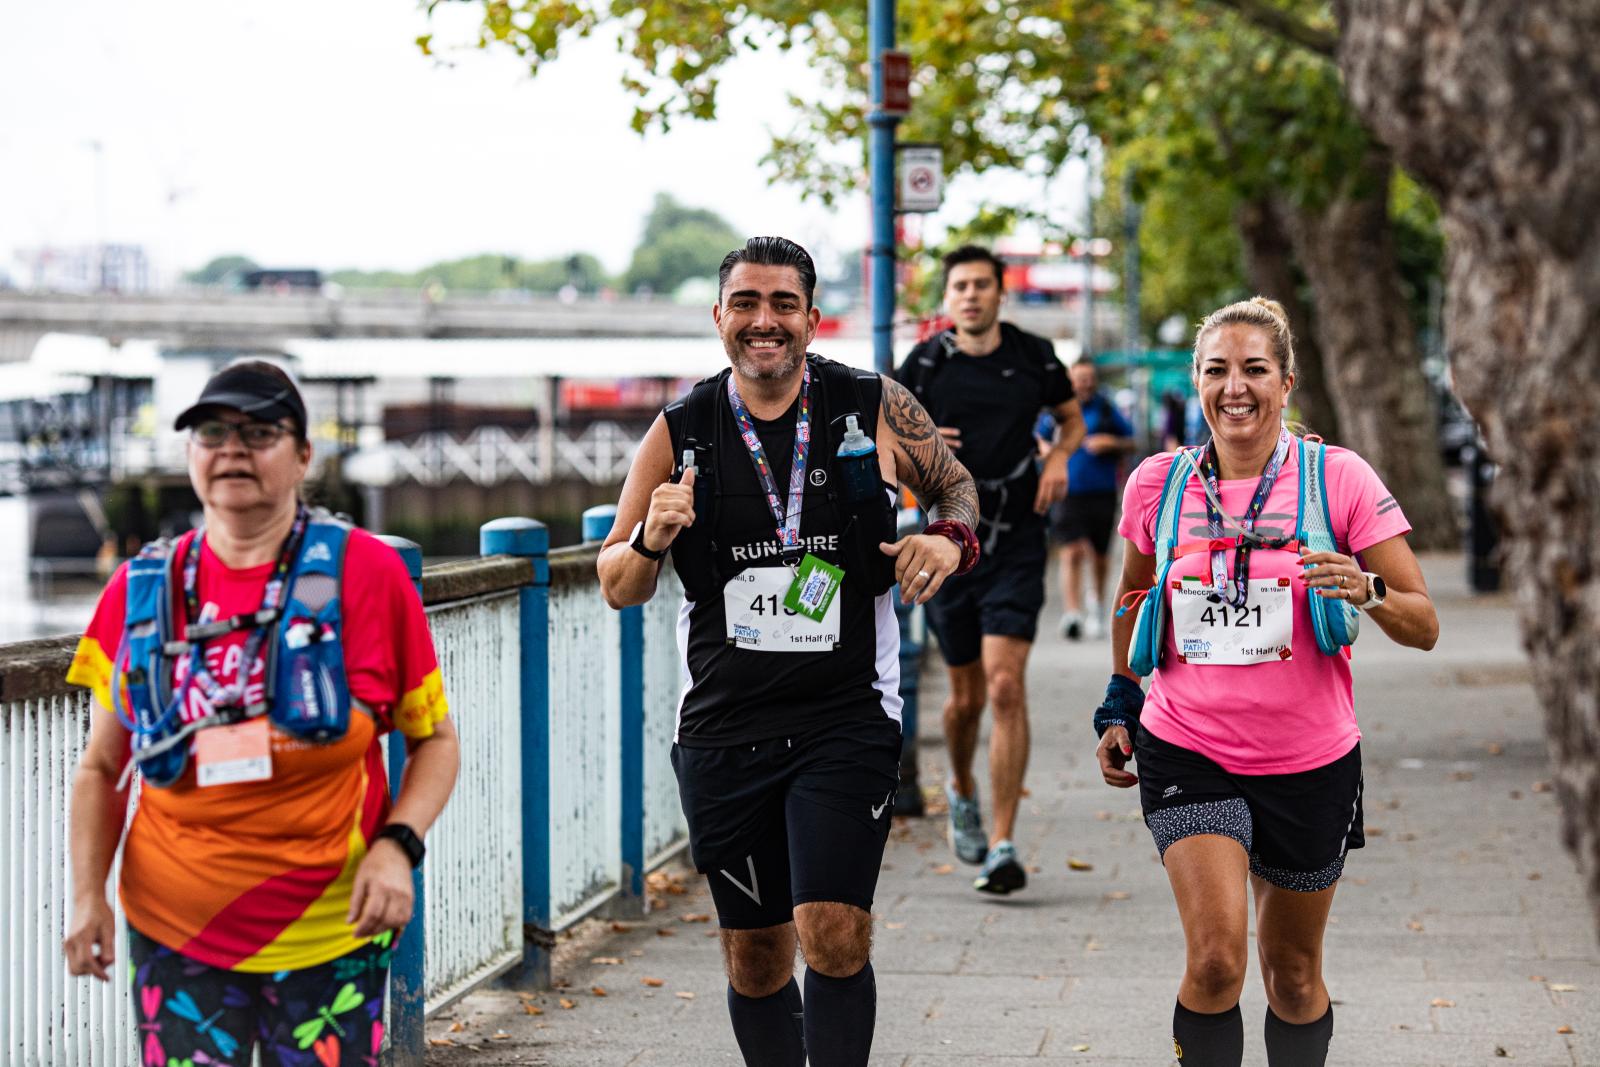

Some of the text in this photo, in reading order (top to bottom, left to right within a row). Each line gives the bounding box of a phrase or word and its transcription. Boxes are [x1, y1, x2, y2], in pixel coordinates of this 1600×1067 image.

[1200, 605, 1261, 627] 4121
[789, 635, 803, 643] 1st
[1241, 647, 1253, 655] 1st
[1256, 646, 1273, 655] Half
